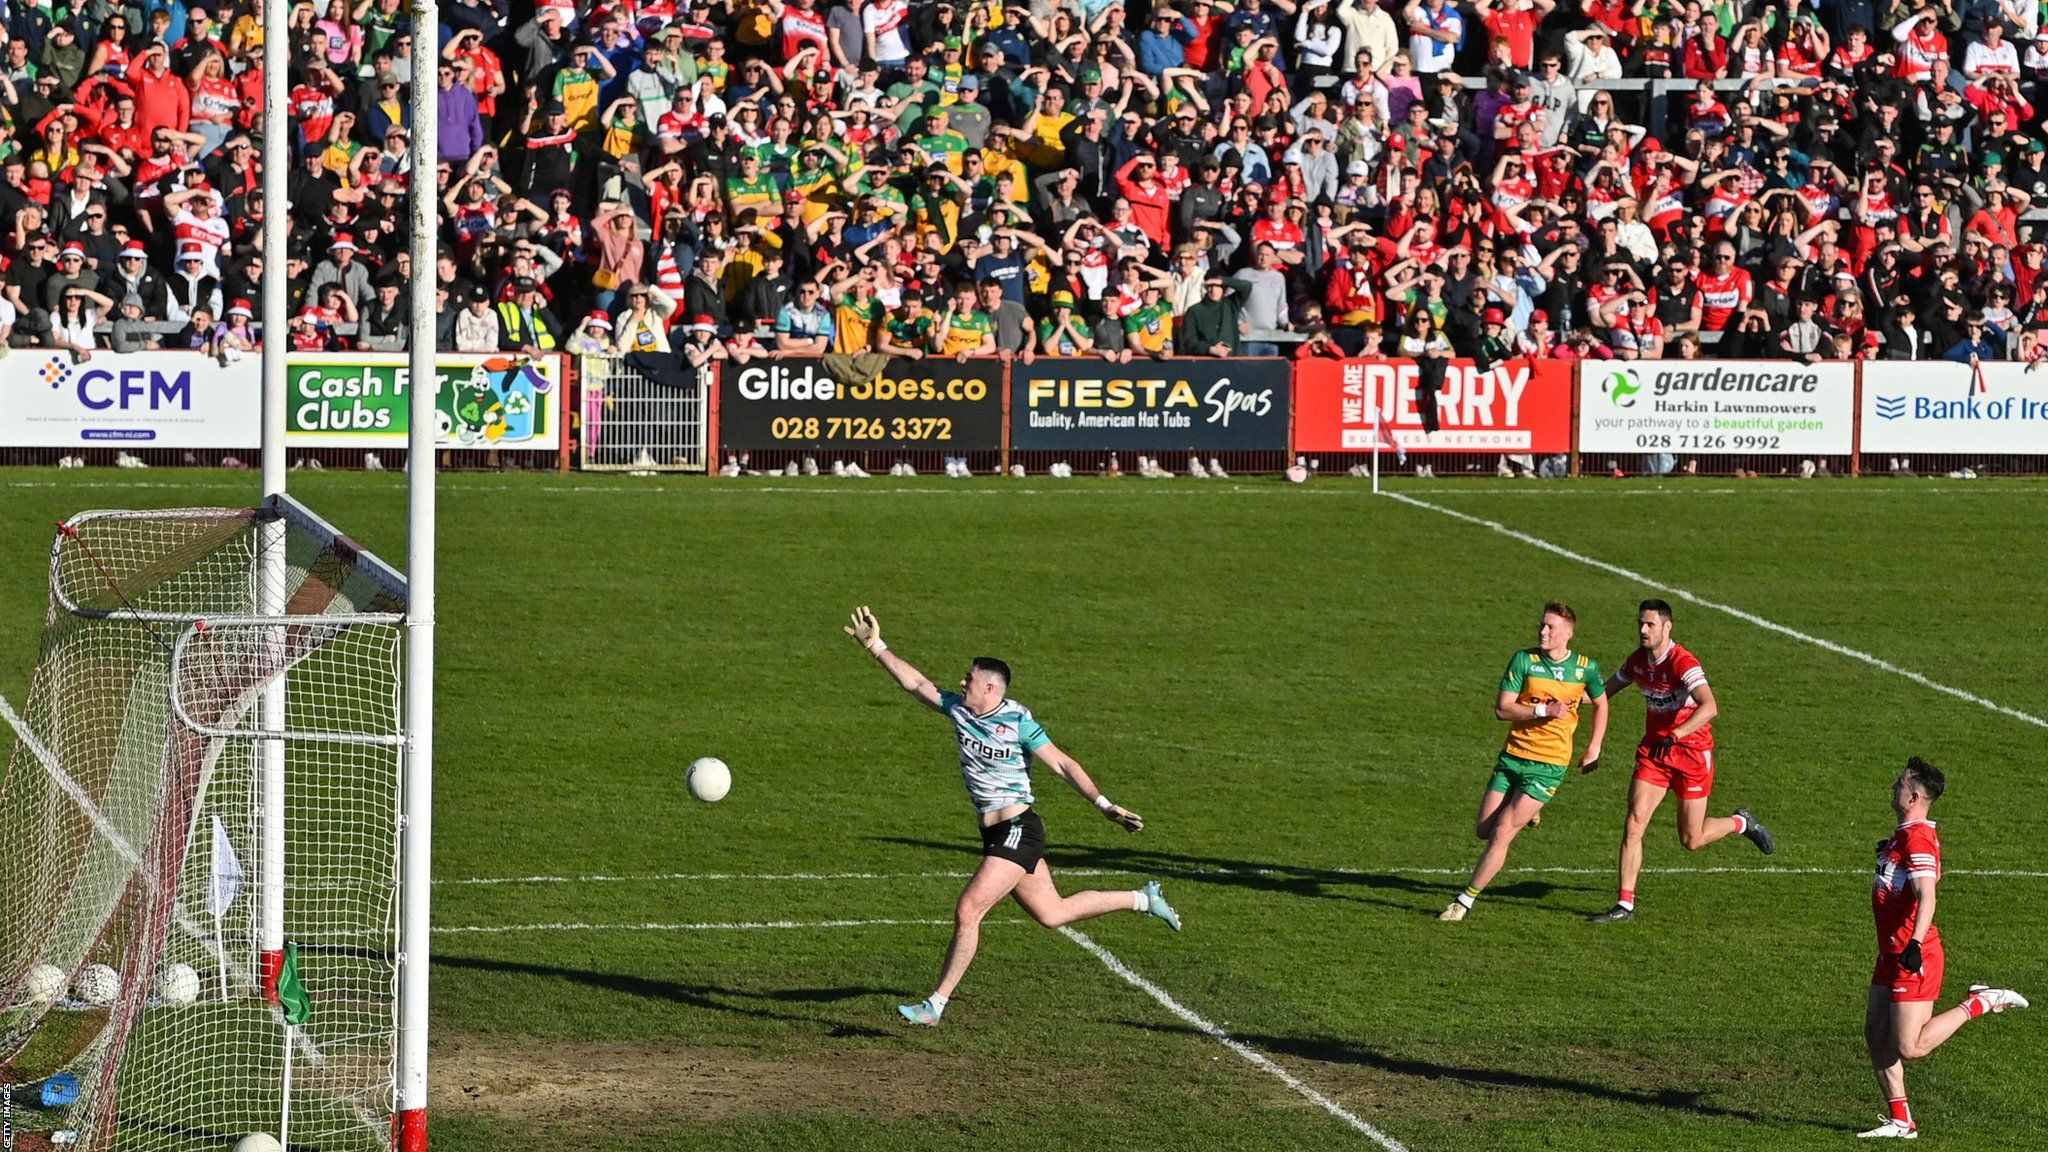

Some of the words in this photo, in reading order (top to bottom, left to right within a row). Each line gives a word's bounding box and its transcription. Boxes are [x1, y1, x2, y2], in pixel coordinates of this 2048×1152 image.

[77, 369, 191, 411] CFM
[299, 368, 383, 399] Cash
[393, 368, 449, 396] Fr
[1343, 363, 1363, 397] ARE
[1654, 367, 1818, 396] gardencare
[1028, 380, 1199, 408] FIESTA
[1203, 378, 1273, 428] Spas
[1363, 364, 1531, 427] DERRY
[1654, 400, 1708, 413] Harkin
[1714, 401, 1816, 414] Lawnmowers
[1915, 396, 1982, 420] Bank
[1987, 396, 2016, 420] of
[296, 400, 391, 430] Clubs
[1078, 411, 1135, 428] American
[1138, 411, 1159, 428] Hot
[1162, 411, 1191, 428] Tubs
[1342, 397, 1362, 424] WE
[1595, 418, 1624, 431] your
[1627, 416, 1683, 431] pathway
[1686, 418, 1700, 429] to
[1703, 420, 1710, 429] a
[1714, 417, 1774, 429] beautiful
[1778, 419, 1824, 432] garden
[771, 417, 820, 440] 028
[826, 417, 885, 440] 7126
[890, 417, 952, 440] 3372
[1445, 435, 1524, 444] NETWORK
[1636, 434, 1671, 448] 028
[1679, 434, 1726, 449] 7126
[1733, 435, 1780, 450] 9992
[957, 731, 1011, 760] Errigal
